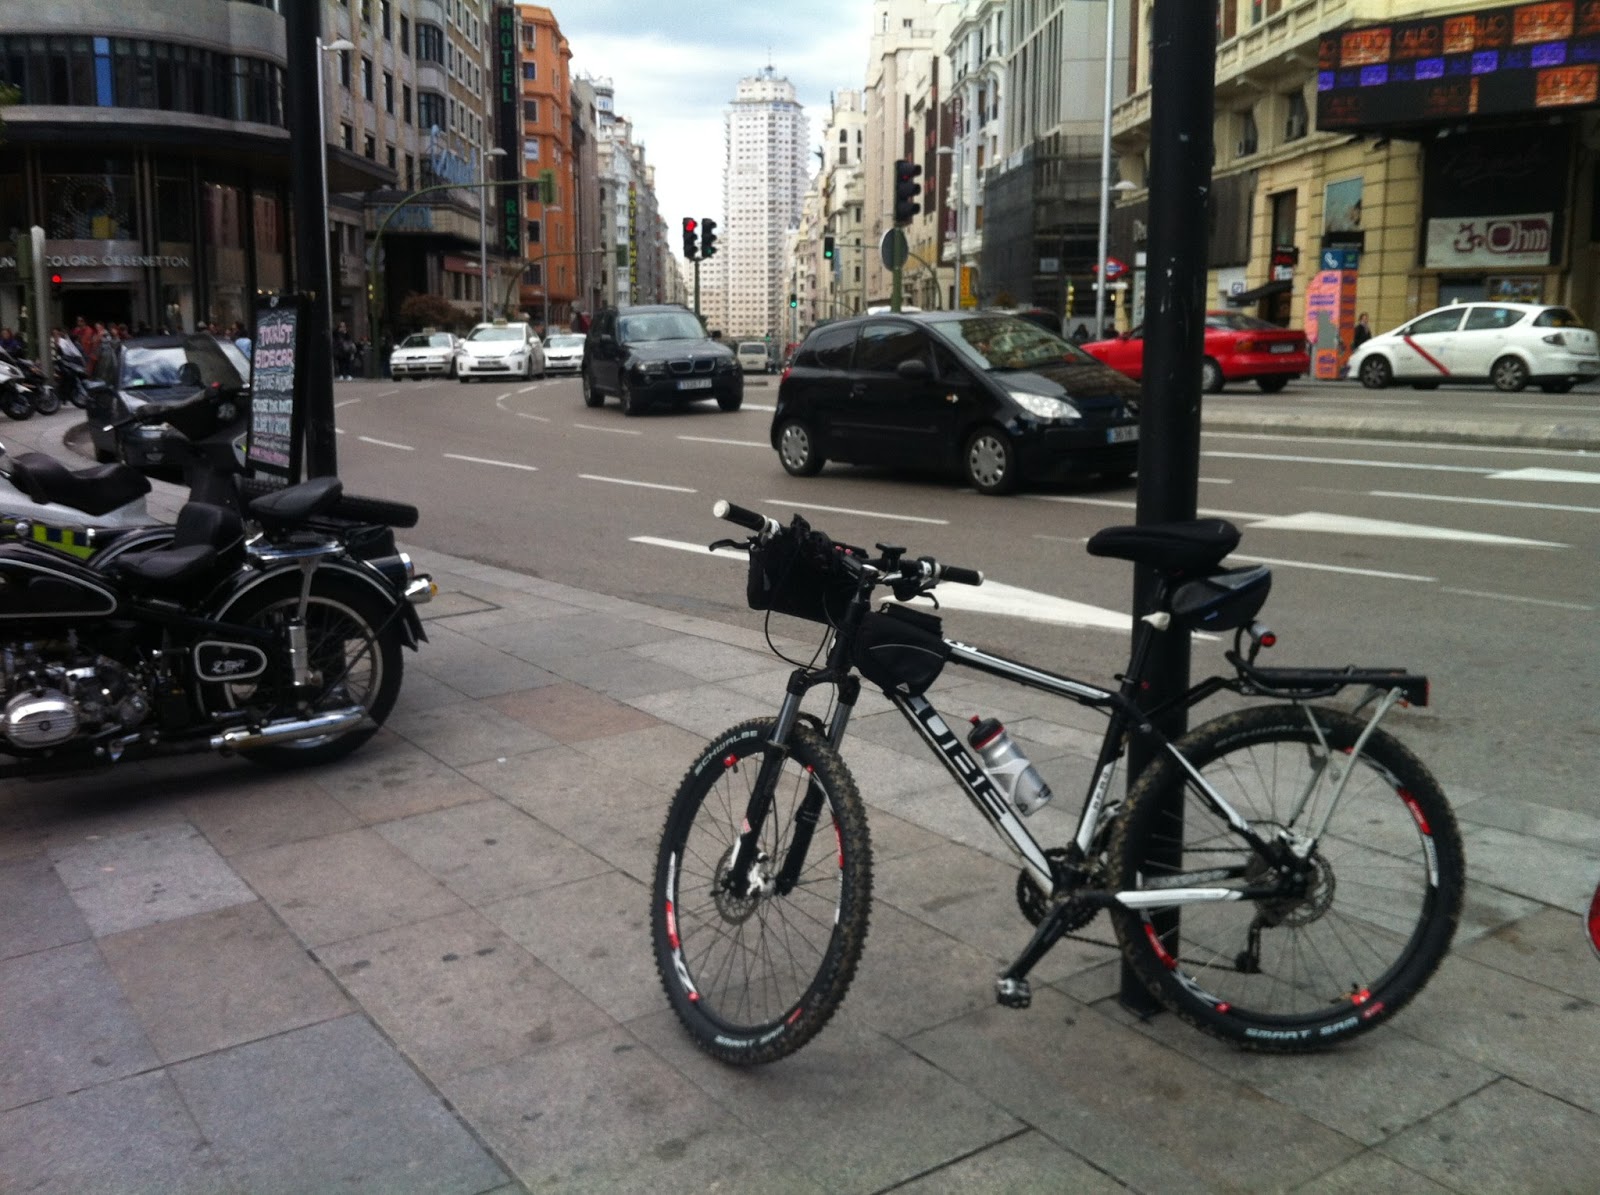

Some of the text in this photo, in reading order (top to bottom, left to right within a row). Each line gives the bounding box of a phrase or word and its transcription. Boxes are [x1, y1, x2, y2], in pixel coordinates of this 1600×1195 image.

[500, 13, 514, 103] HOTEL
[505, 200, 519, 251] REX
[1487, 221, 1548, 253] Ohm
[121, 255, 190, 268] BENETTON
[254, 348, 295, 370] SIDECAR
[694, 729, 759, 777] SCHWALBE
[1244, 1015, 1360, 1041] SMART SAM
